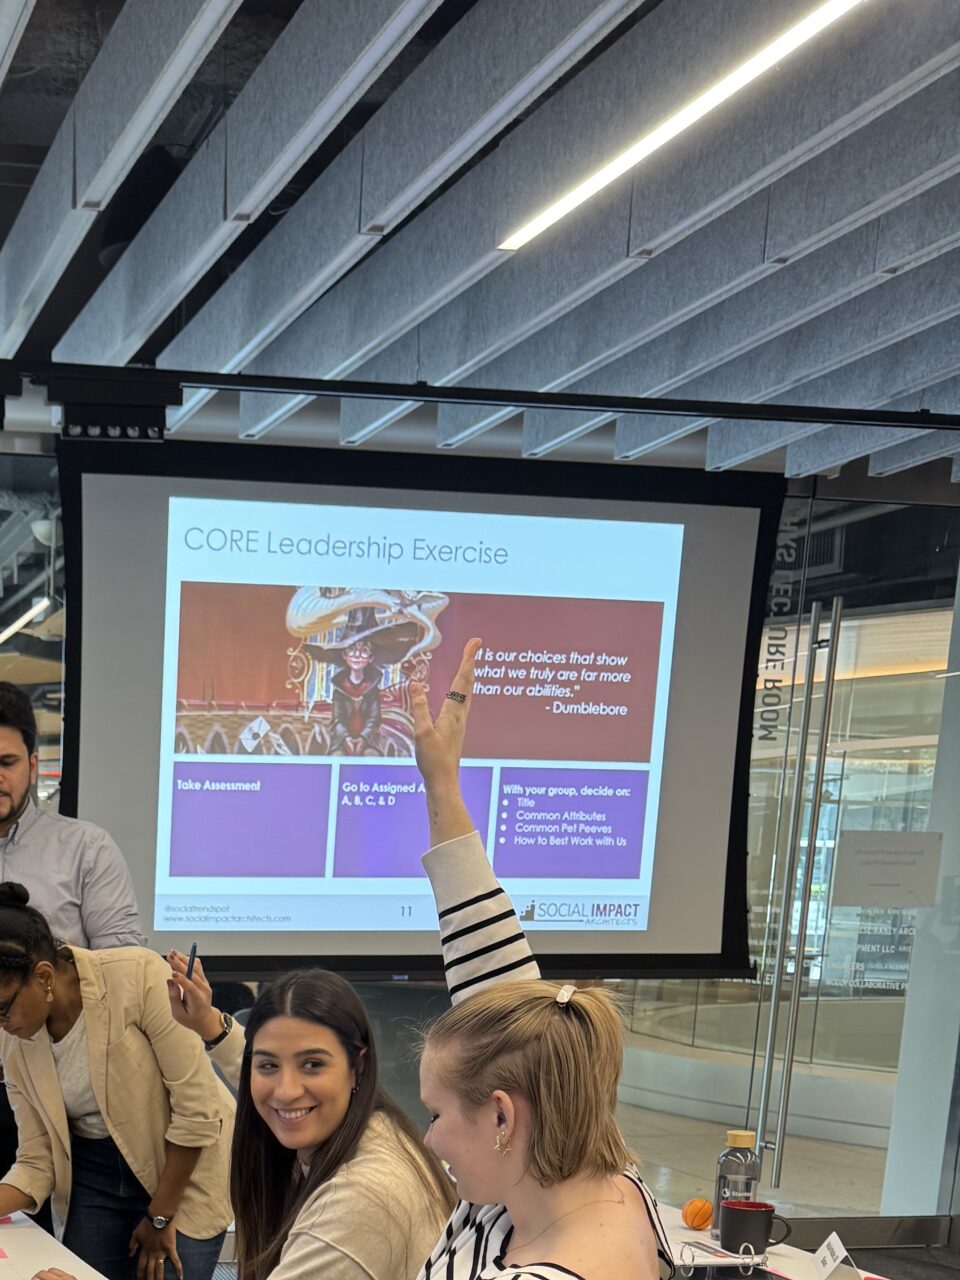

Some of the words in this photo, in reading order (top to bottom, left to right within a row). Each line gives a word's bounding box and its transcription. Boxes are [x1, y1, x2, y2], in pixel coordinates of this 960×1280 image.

[183, 526, 259, 553] CORE
[267, 530, 404, 565] Leadership
[412, 538, 509, 565] Exercise
[485, 648, 494, 661] is
[496, 651, 516, 662] our
[519, 650, 567, 664] choices
[569, 651, 595, 665] that
[596, 653, 628, 666] show
[474, 666, 505, 679] what
[508, 668, 526, 679] we
[530, 667, 555, 682] truly
[557, 670, 577, 681] are
[580, 669, 598, 681] far
[600, 672, 631, 683] more
[473, 682, 500, 695] than
[503, 685, 524, 696] our
[552, 701, 628, 716] Dumblebore
[176, 779, 201, 791] Take
[203, 780, 261, 792] Assessment
[342, 782, 358, 793] Go
[359, 782, 370, 793] to
[372, 782, 416, 795] Assigned
[503, 784, 523, 795] With
[525, 786, 546, 796] your
[548, 786, 578, 797] group,
[580, 786, 613, 796] decide
[615, 787, 631, 797] on:
[341, 795, 352, 806] A,
[378, 796, 386, 806] &
[387, 796, 396, 806] D
[517, 797, 535, 807] Title
[516, 810, 560, 821] Common
[562, 811, 606, 822] Attributes
[515, 823, 559, 833] Common
[561, 823, 577, 833] Pet
[579, 823, 612, 834] Peeves
[514, 835, 535, 845] How
[538, 836, 547, 846] to
[549, 836, 568, 846] Best
[571, 836, 593, 846] Work
[596, 836, 615, 846] with
[617, 837, 627, 847] Us
[400, 905, 413, 917] 11
[537, 902, 589, 918] SOCIAL
[591, 903, 640, 918] IMPACT
[585, 918, 638, 927] ARCHITECTS
